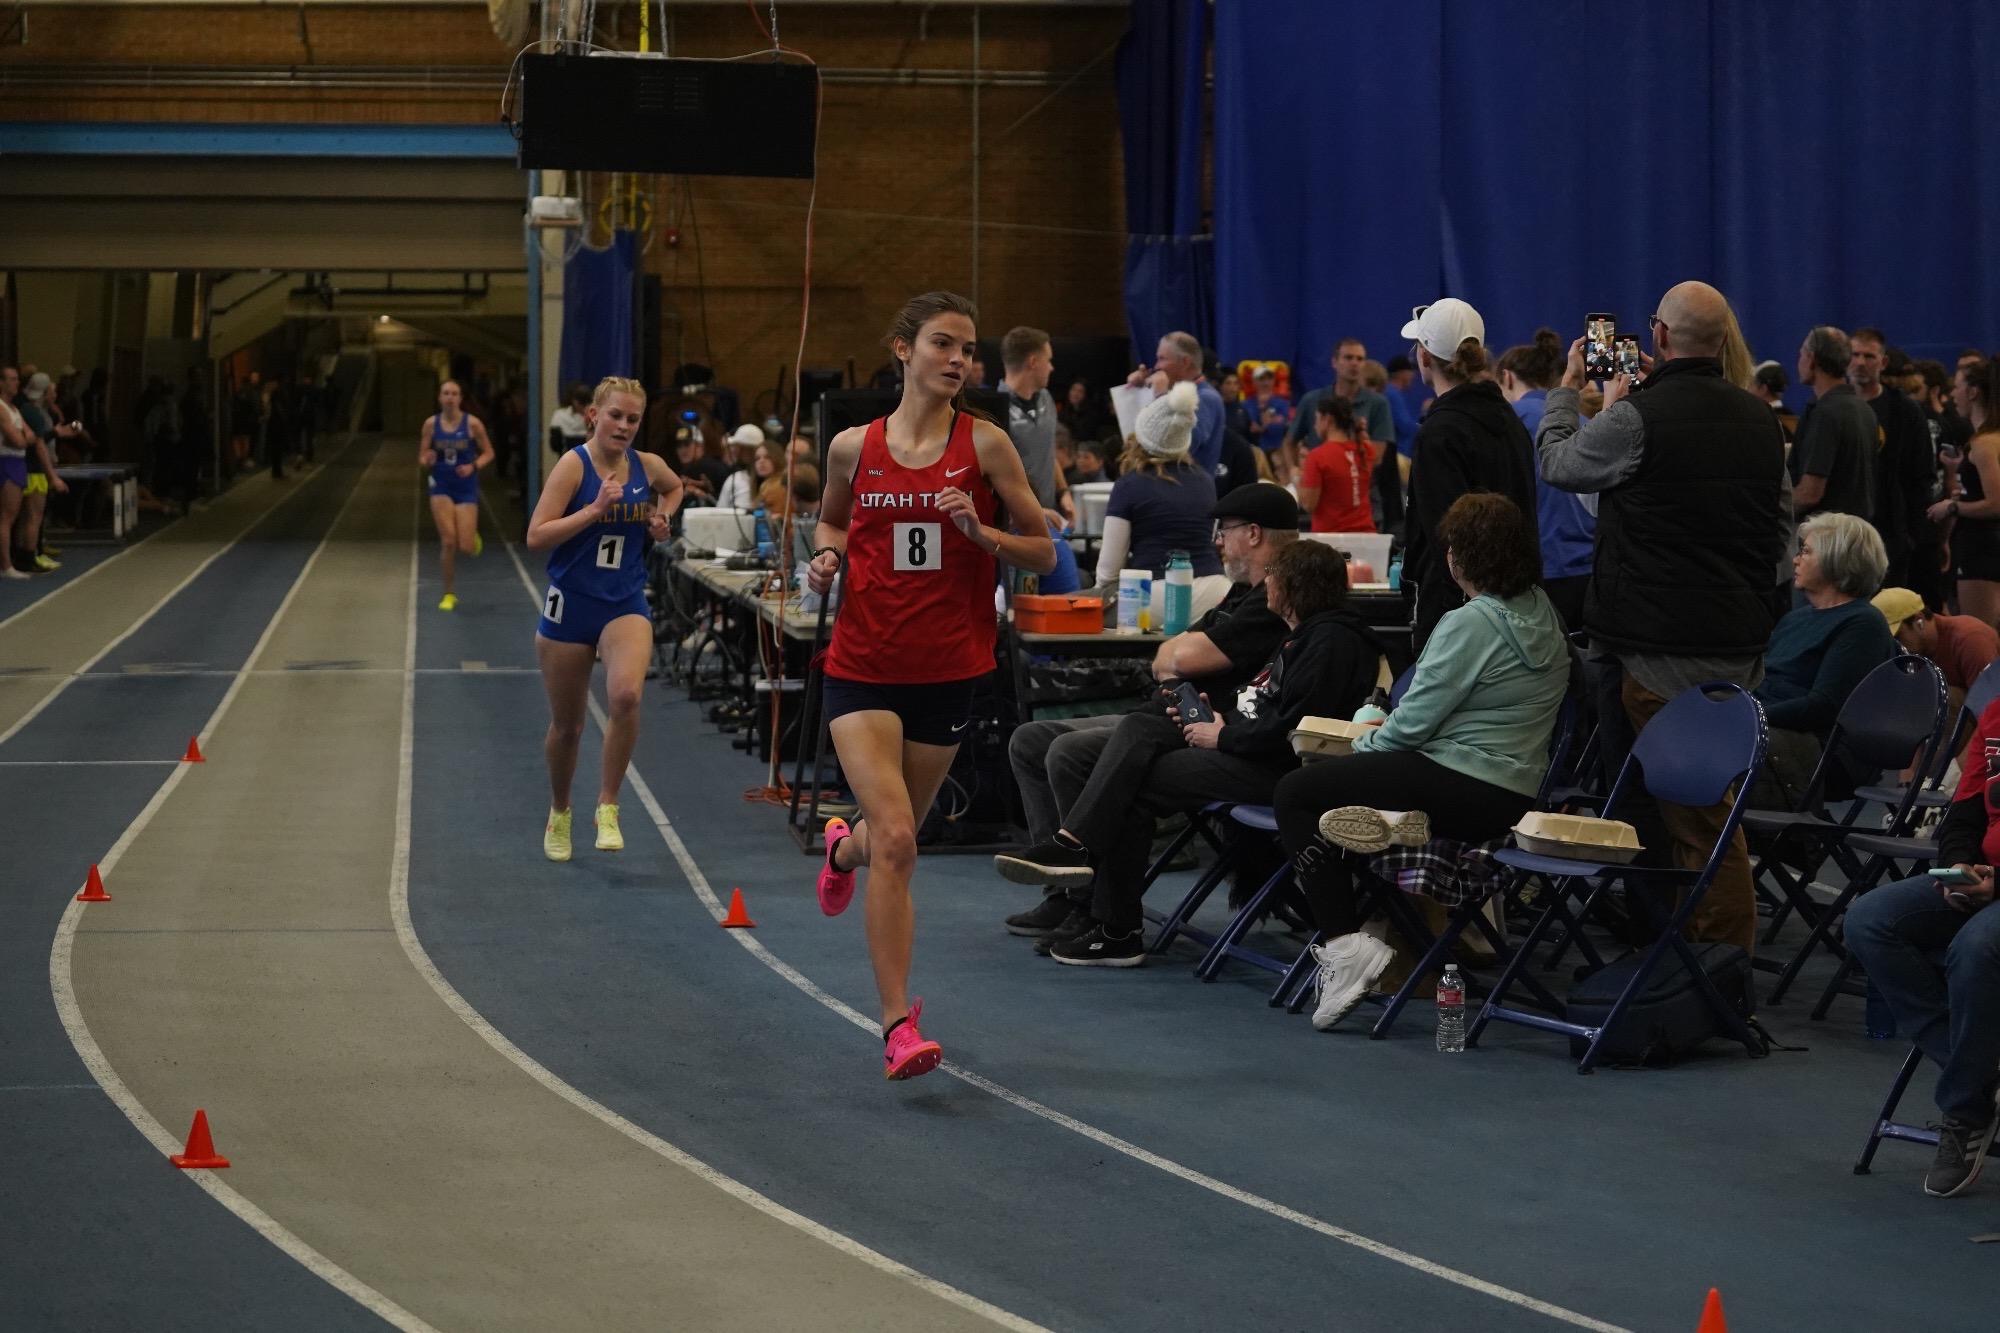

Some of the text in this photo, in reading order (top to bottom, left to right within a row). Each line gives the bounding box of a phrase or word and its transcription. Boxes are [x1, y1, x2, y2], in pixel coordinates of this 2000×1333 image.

[860, 493, 913, 508] UTAH
[601, 539, 617, 565] 1
[908, 527, 927, 566] 8
[548, 593, 560, 618] 1
